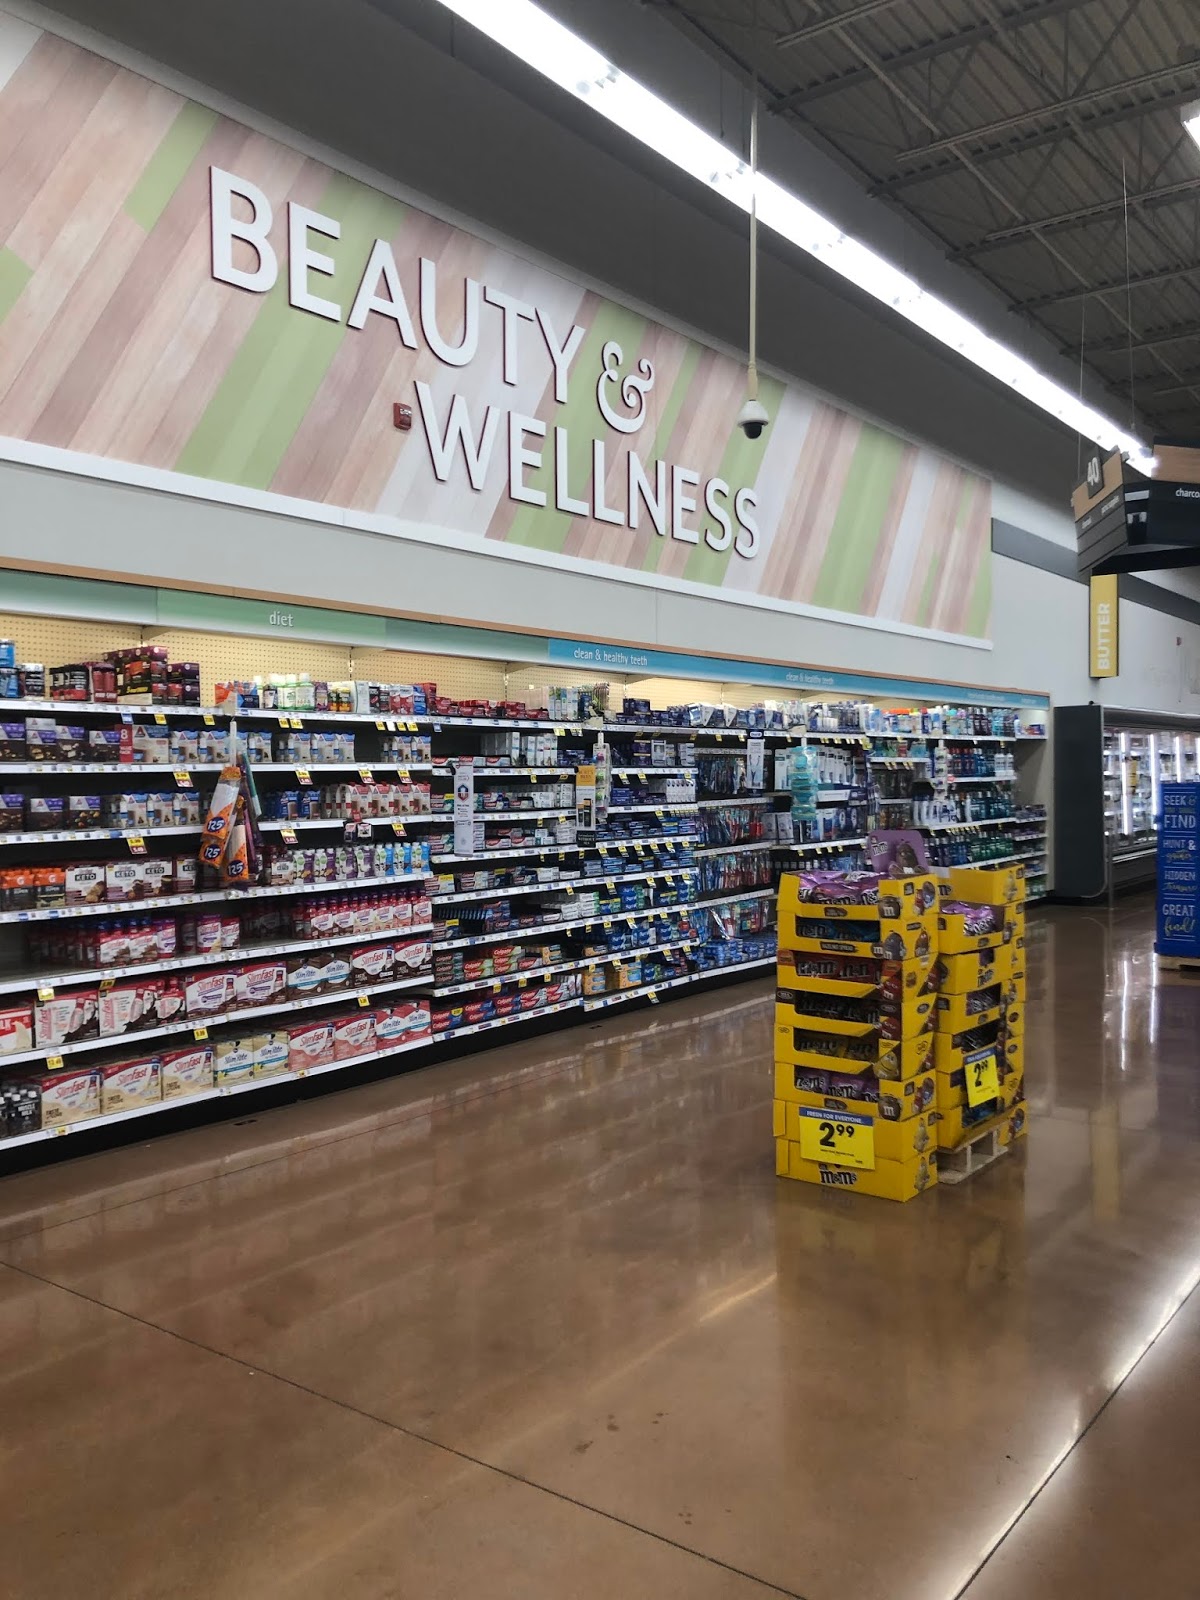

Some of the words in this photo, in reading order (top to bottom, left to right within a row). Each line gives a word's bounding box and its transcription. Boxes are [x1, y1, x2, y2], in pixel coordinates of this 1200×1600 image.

[209, 165, 585, 404] BEAUTY
[597, 340, 655, 434] &
[414, 380, 761, 559] WELLNESS
[1087, 457, 1099, 486] 40
[1175, 488, 1200, 498] charco
[270, 611, 293, 627] diet
[1098, 603, 1111, 670] BUTTER
[573, 647, 593, 659] clean
[595, 648, 602, 661] &
[603, 650, 629, 665] healthy
[630, 654, 648, 666] teeth
[120, 729, 128, 739] 8
[1164, 795, 1187, 806] SEEK
[207, 820, 225, 832] 125
[1164, 814, 1197, 829] FIND
[1162, 839, 1186, 849] HUNT
[1188, 840, 1197, 850] &
[204, 847, 220, 858] 125
[146, 867, 164, 875] KETO
[227, 862, 244, 875] 125
[1164, 871, 1196, 881] HIDDEN
[1162, 904, 1195, 916] GREAT
[361, 952, 384, 966] SlimFast
[402, 945, 424, 959] SlimFast
[246, 968, 275, 983] SlimFast
[197, 976, 225, 992] SlimFast
[344, 1020, 368, 1037] SlimFast
[300, 1030, 325, 1046] SlimFast
[174, 1053, 202, 1073] SlimFast
[116, 1067, 148, 1086] SlimFast
[55, 1080, 87, 1099] SlimFast
[823, 1112, 835, 1120] FOR
